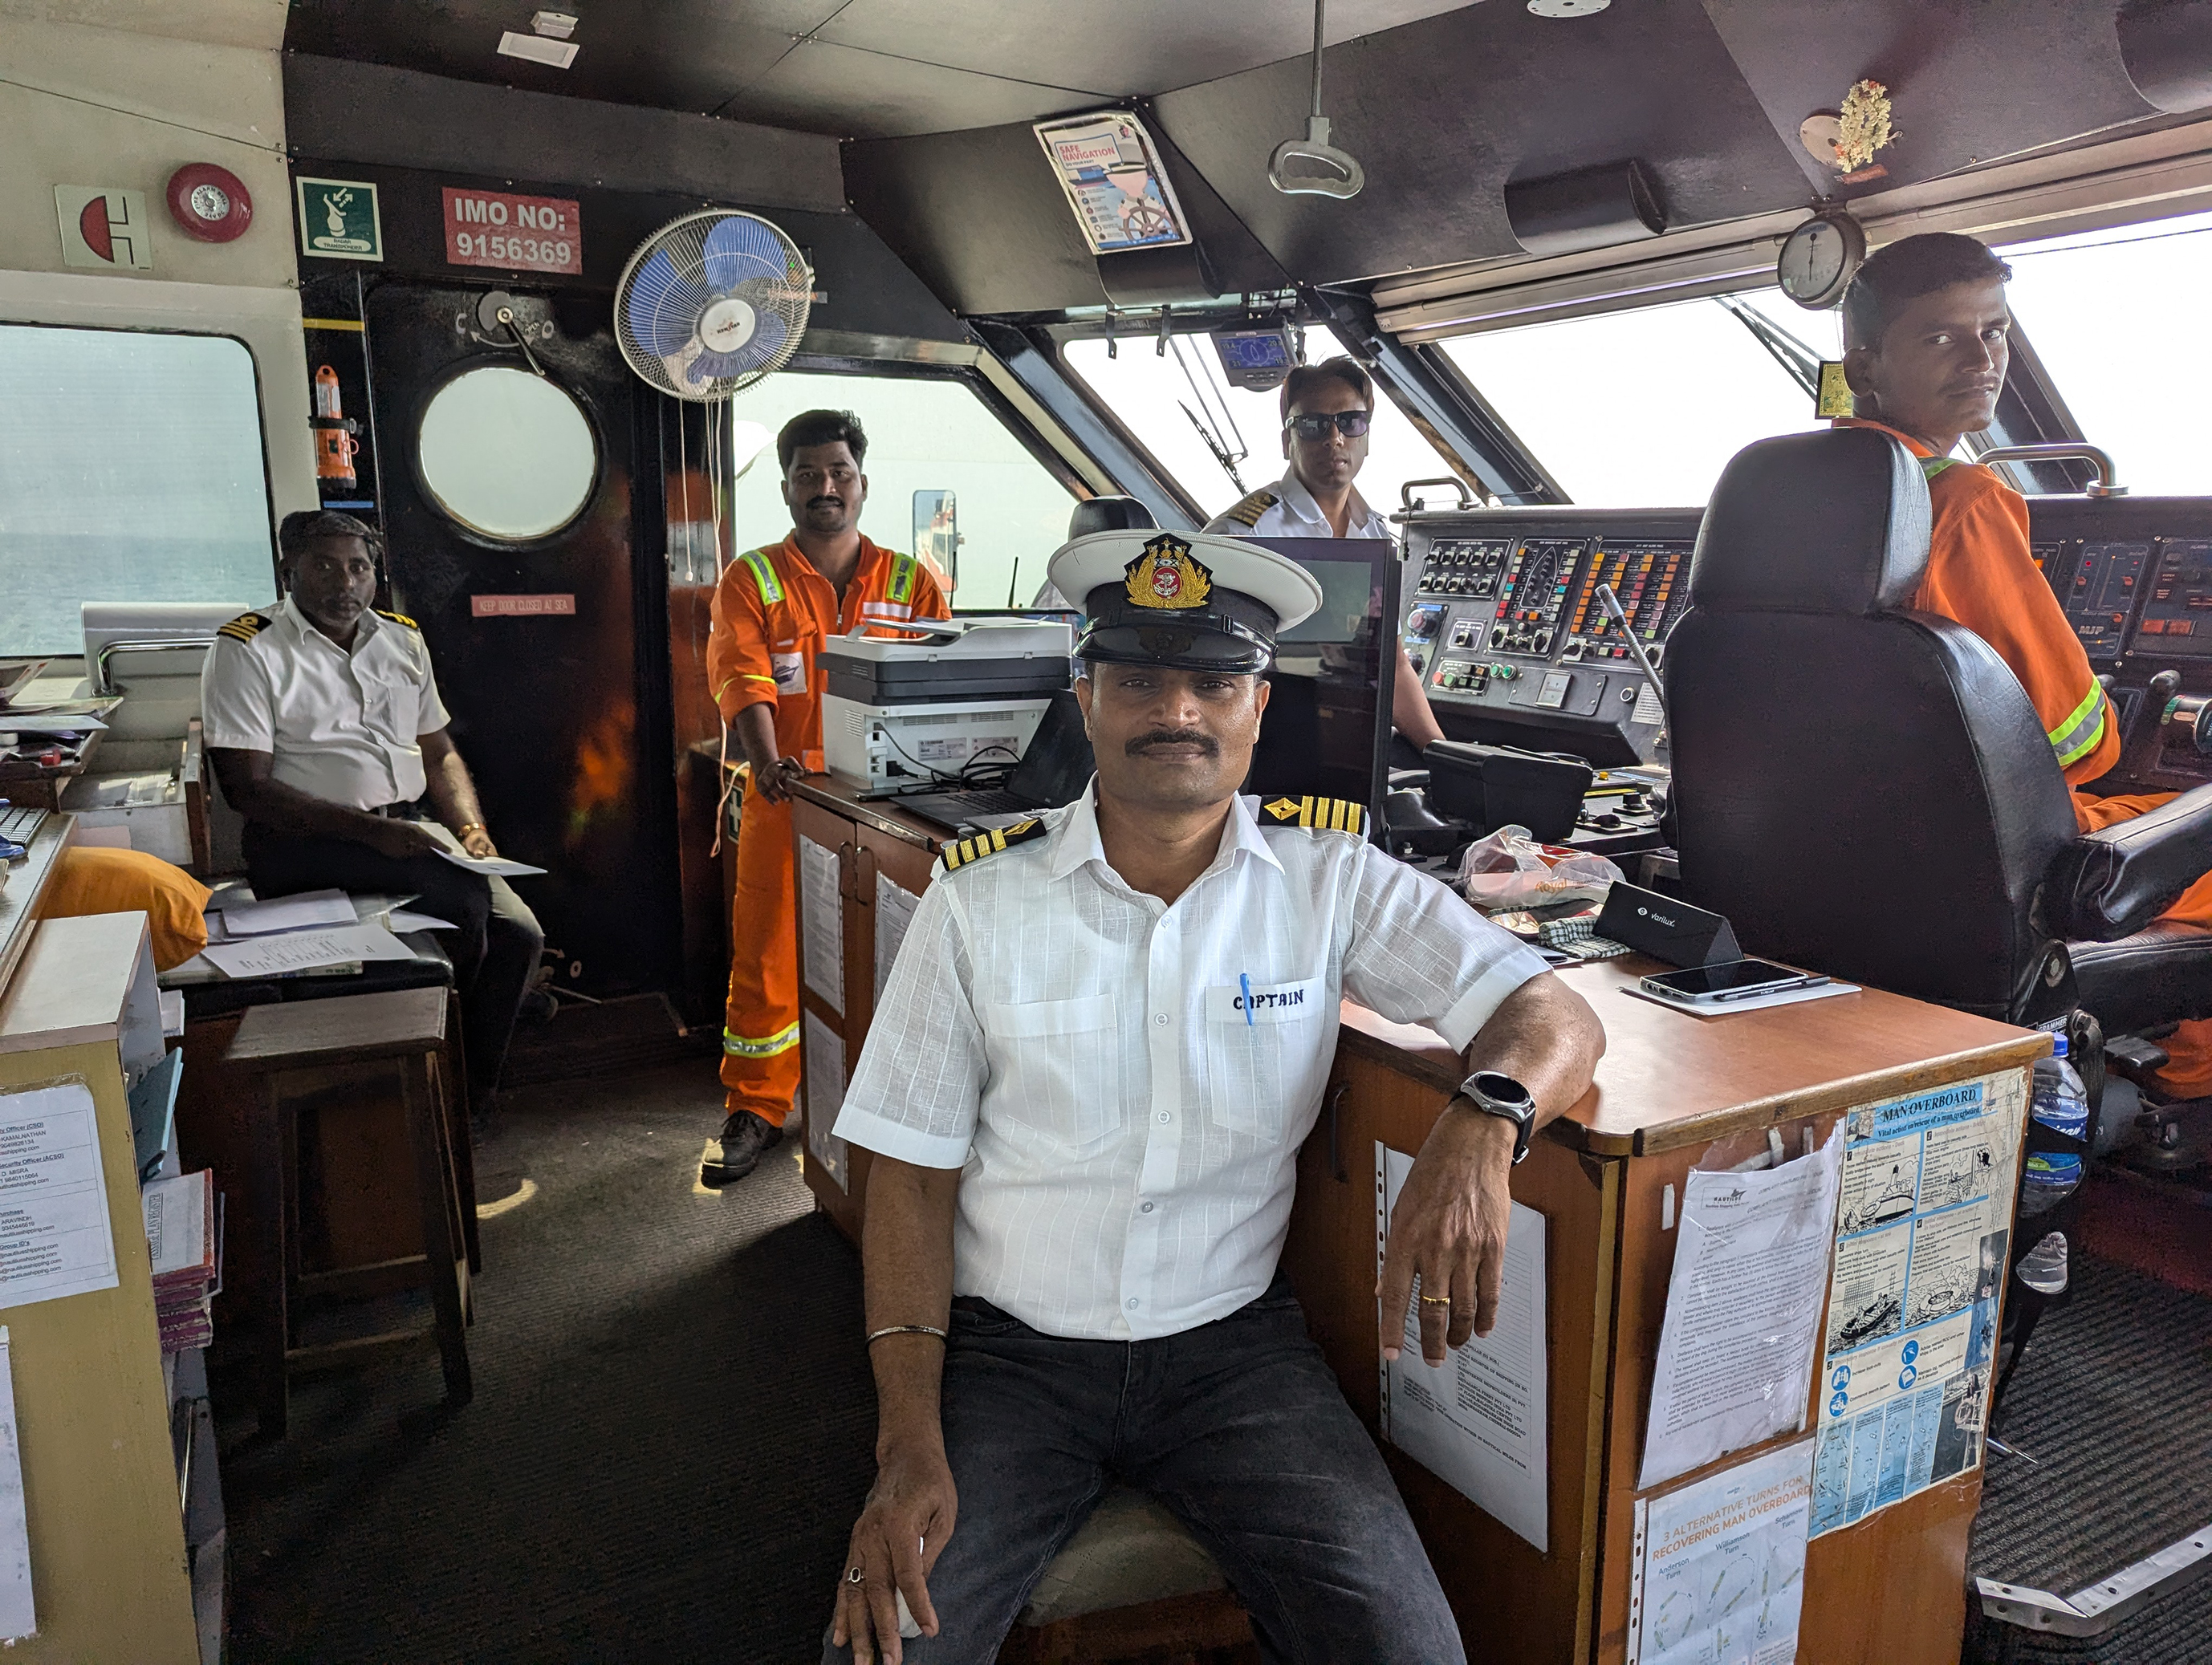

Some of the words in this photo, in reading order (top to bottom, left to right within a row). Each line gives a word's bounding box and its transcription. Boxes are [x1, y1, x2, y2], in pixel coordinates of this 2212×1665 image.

[1059, 145, 1080, 154] SAFE
[1062, 147, 1115, 161] NAVIGATION
[197, 187, 216, 195] ALARM
[218, 191, 227, 205] BELL
[455, 197, 508, 226] IMO
[518, 204, 565, 231] NO:
[457, 233, 571, 265] 9156369
[456, 313, 467, 335] C
[524, 321, 540, 335] OPEN
[480, 599, 495, 611] KEEP
[498, 599, 515, 611] DOOR
[518, 599, 543, 611] CLOSED
[545, 599, 552, 611] AT
[555, 599, 568, 611] SEA
[1535, 880, 1567, 894] Royal
[2038, 1017, 2068, 1033] GRAMMER
[1882, 1104, 1908, 1123] MAN
[1909, 1089, 1976, 1115] OVERBOARD
[26, 1122, 43, 1130] (CSO)
[1878, 1129, 1891, 1137] Vital
[1892, 1124, 1907, 1134] action
[1942, 1113, 1953, 1121] man
[1954, 1107, 1981, 1120] overboard
[1, 1130, 47, 1142] KAMALNATHAN
[22, 1157, 42, 1165] Officer
[43, 1153, 64, 1162] (ACSO)
[1, 1216, 32, 1225] ARAVINDH
[1852, 1368, 1866, 1376] Increase
[1849, 1391, 1868, 1403] Commence
[1868, 1387, 1879, 1395] search
[1879, 1383, 1890, 1391] pattern
[1663, 1531, 1670, 1542] 3
[1673, 1501, 1744, 1539] ALTERNATIVE
[1746, 1486, 1779, 1506] TURNS
[1783, 1475, 1804, 1490] FOR
[1653, 1524, 1720, 1561] RECOVERING
[1722, 1513, 1746, 1530] MAN
[1748, 1484, 1813, 1518] OVERBOARD
[1781, 1519, 1795, 1529] Turn
[1715, 1532, 1750, 1551] Williamson
[1724, 1545, 1739, 1555] Turn
[1658, 1557, 1689, 1576] Anderson
[1665, 1570, 1681, 1581] Turn
